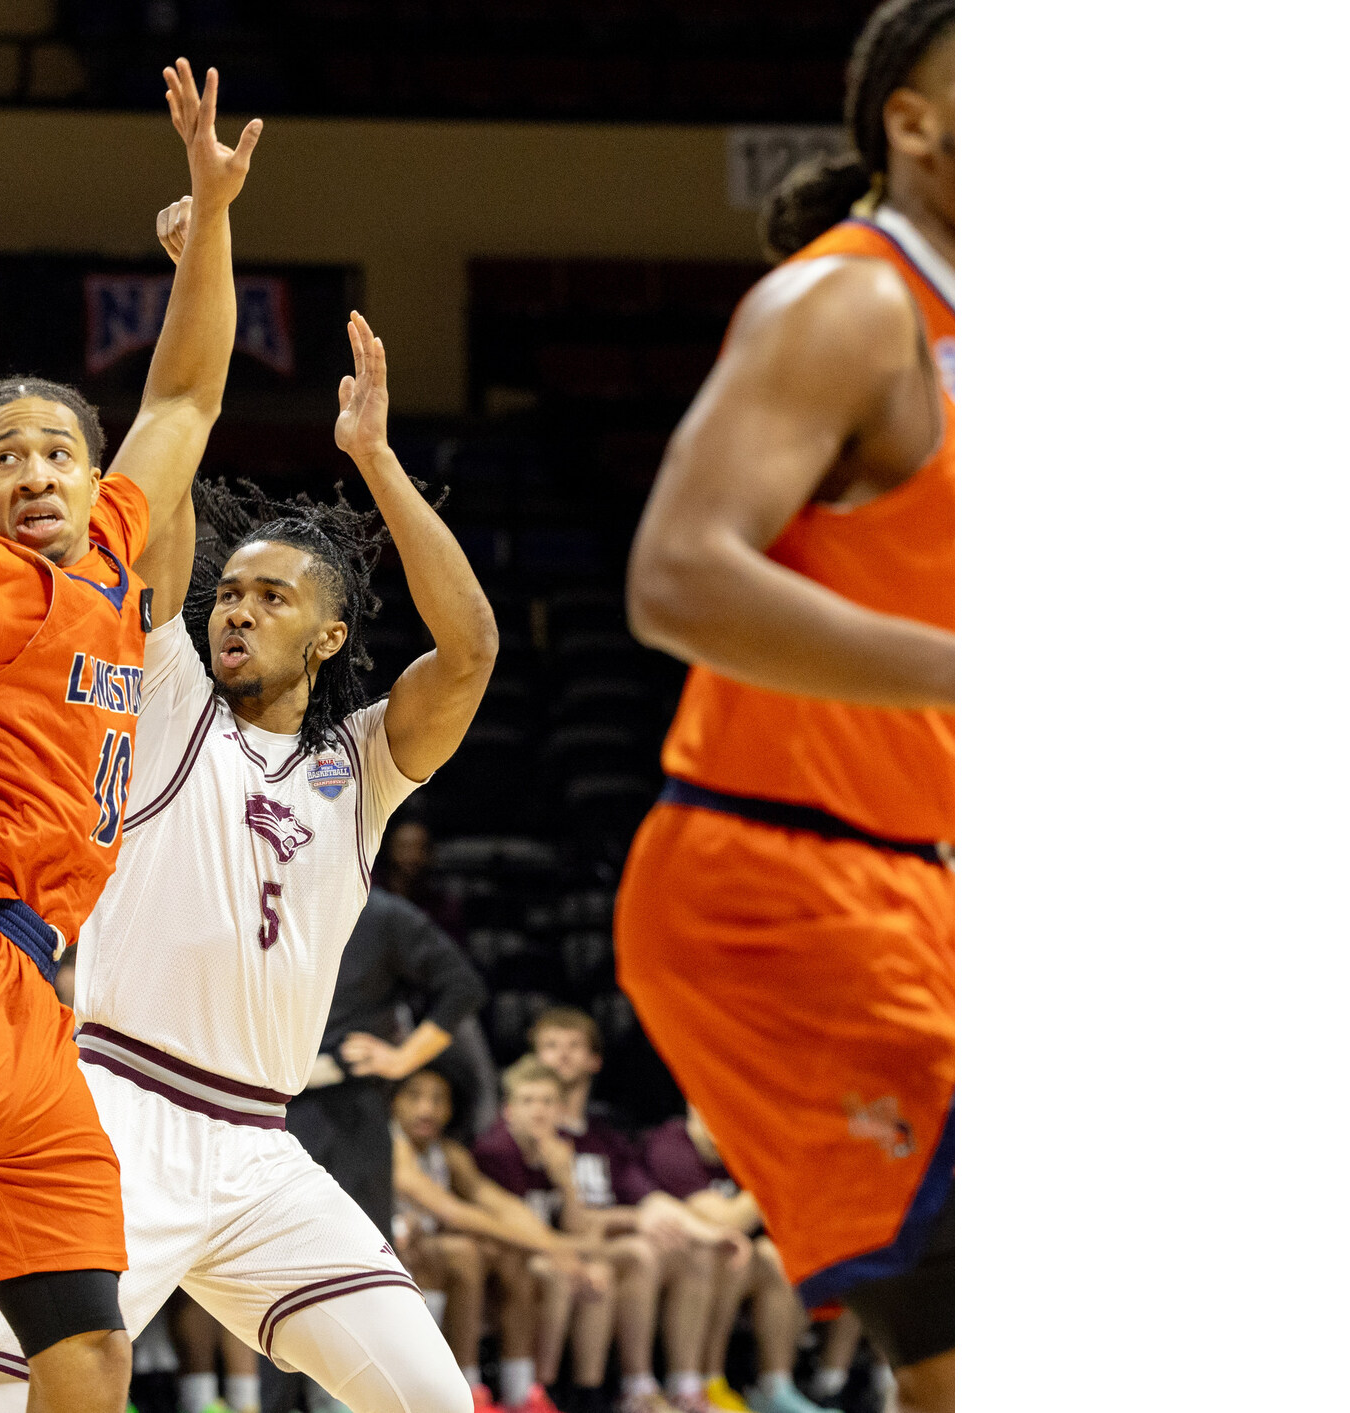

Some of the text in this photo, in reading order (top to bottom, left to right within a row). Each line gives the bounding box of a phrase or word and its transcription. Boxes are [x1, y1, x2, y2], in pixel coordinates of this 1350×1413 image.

[99, 287, 278, 352] NA
[89, 728, 134, 849] 10
[307, 767, 350, 779] BASKETBALL
[257, 880, 283, 952] 5
